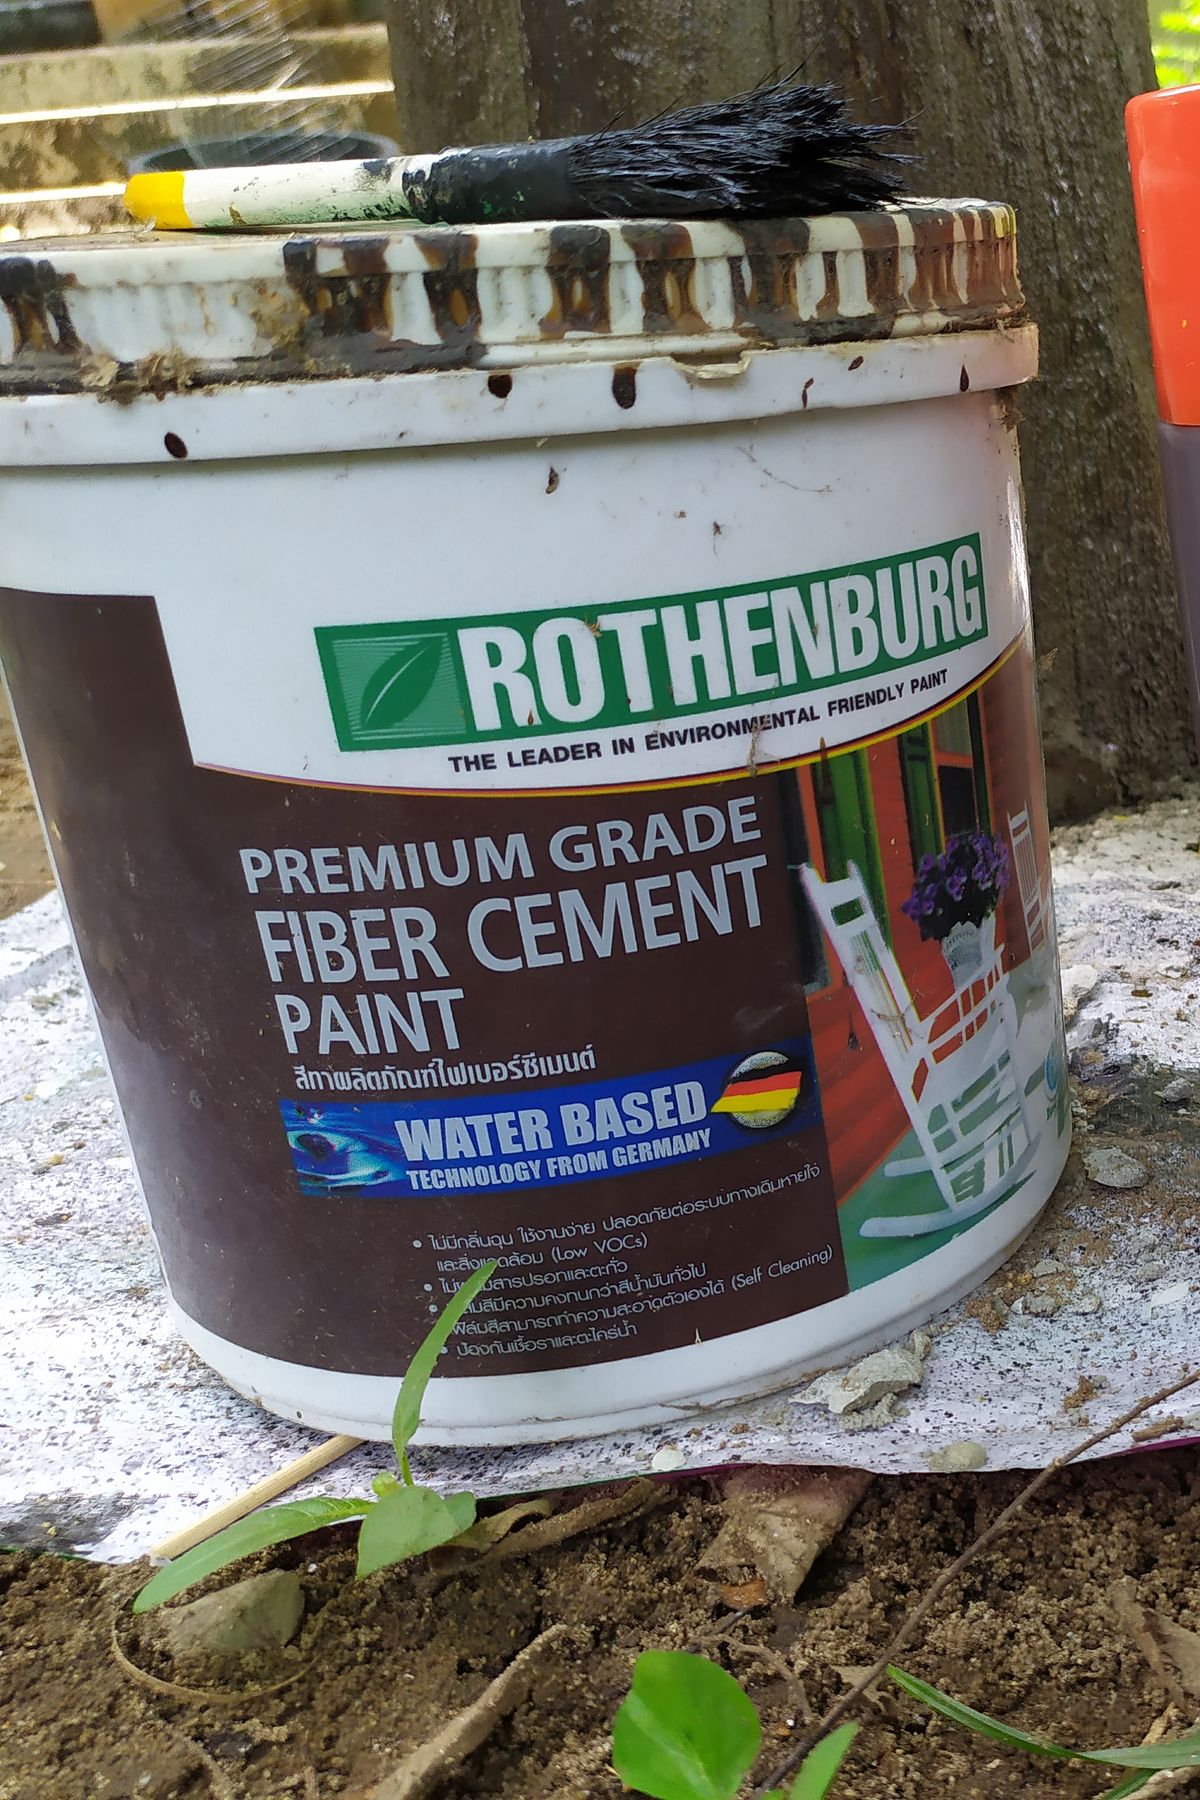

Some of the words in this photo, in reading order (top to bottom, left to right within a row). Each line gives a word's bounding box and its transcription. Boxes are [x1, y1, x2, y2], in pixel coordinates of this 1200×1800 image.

[457, 546, 984, 732] ROTHENBURG
[449, 754, 502, 774] THE
[507, 741, 602, 768] LEADER
[611, 737, 635, 754] IN
[644, 708, 821, 751] ENVIRONMENTAL
[827, 682, 906, 719] FRIENDLY
[911, 669, 949, 698] PAINT
[239, 832, 535, 894] PREMIUM
[549, 796, 762, 872] GRADE
[255, 907, 451, 983] FIBER
[467, 854, 768, 973] CEMENT
[274, 988, 464, 1056] PAINT
[395, 1107, 551, 1162] WATER
[561, 1080, 707, 1147] BASED
[406, 1159, 542, 1191] TECHNOLOGY
[547, 1147, 607, 1177] FROM
[611, 1127, 712, 1166] GERMANY
[428, 1230, 514, 1251] ไม่มีกลิ่นฉุน
[517, 1221, 596, 1244] ใช้งานง่าย
[551, 1246, 588, 1264] (Low
[593, 1231, 649, 1254] VOCs)
[731, 1269, 763, 1291] (Self
[768, 1244, 834, 1278] Cleaning)
